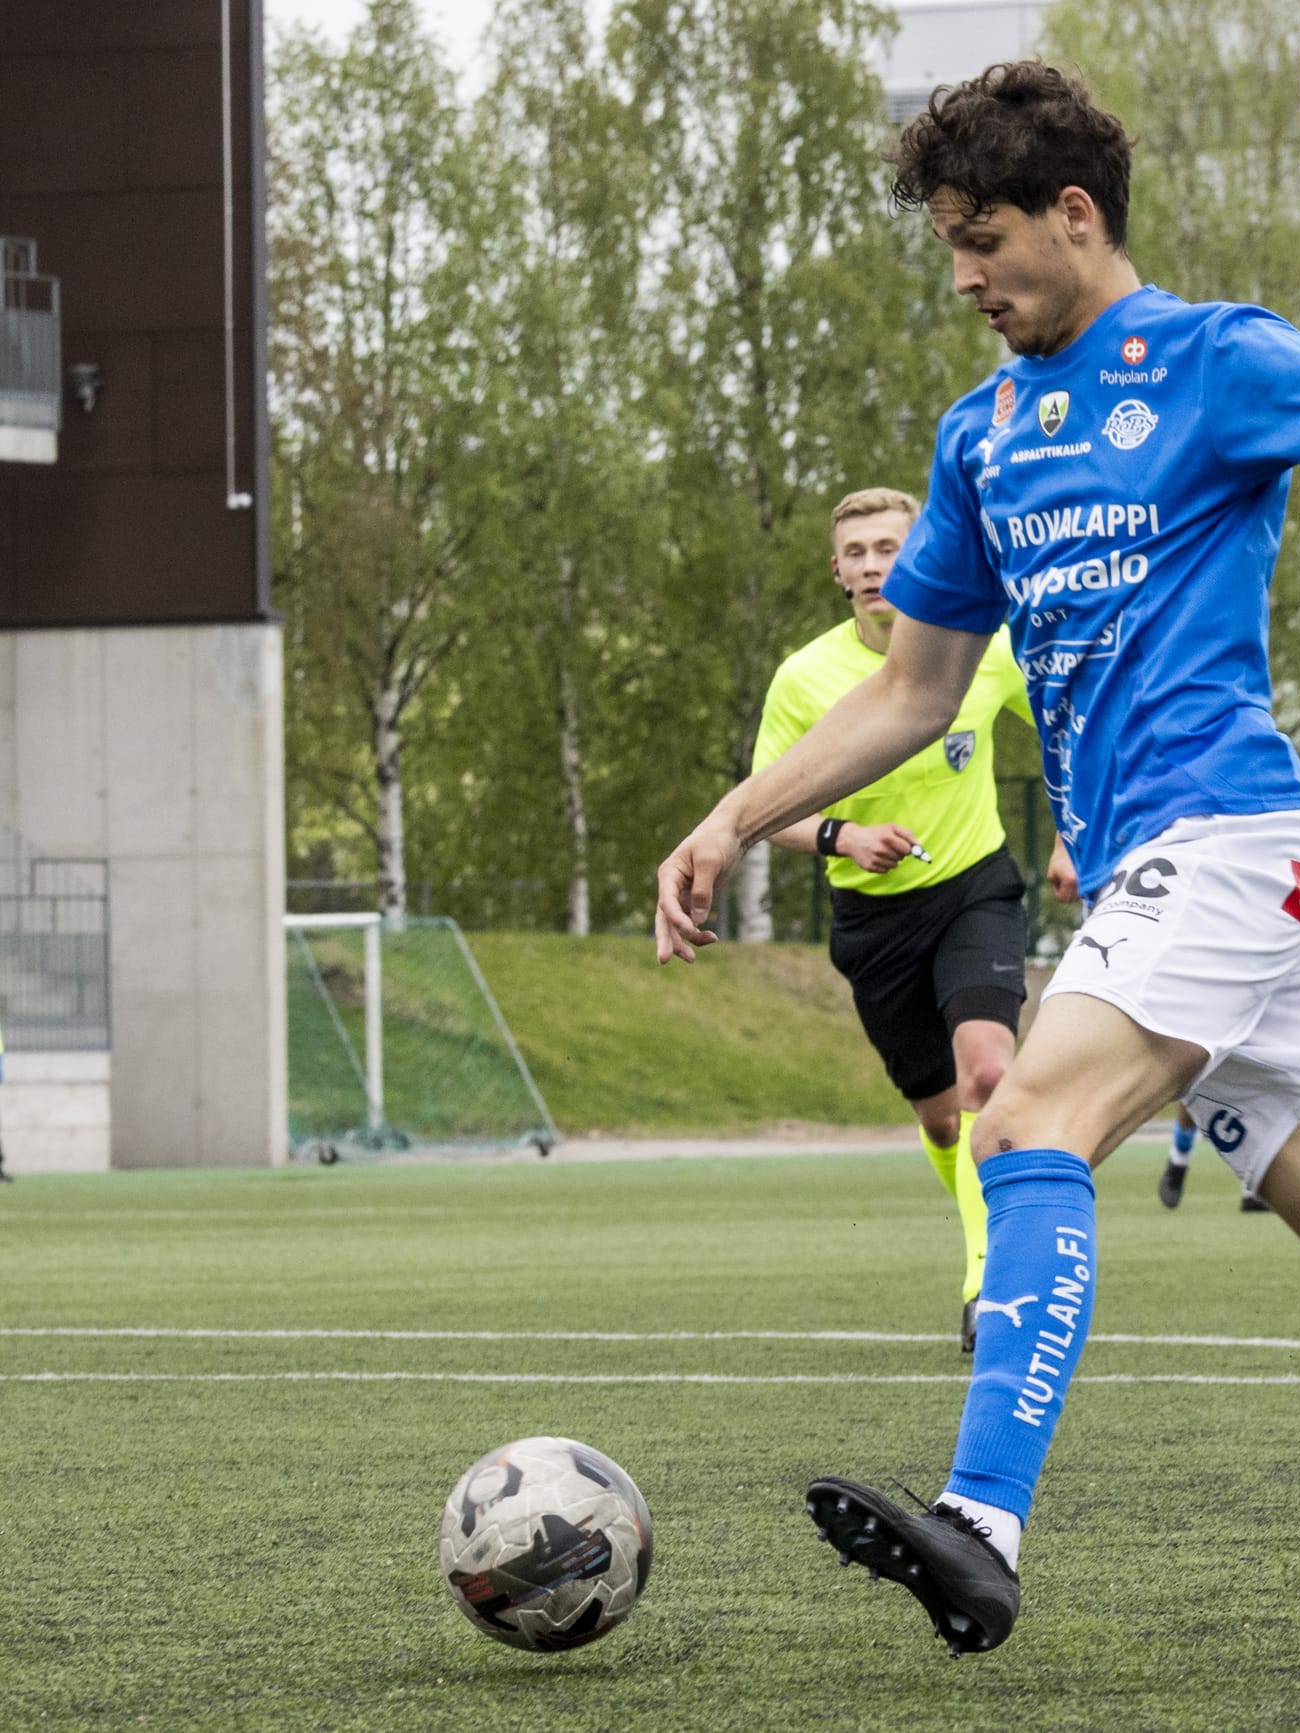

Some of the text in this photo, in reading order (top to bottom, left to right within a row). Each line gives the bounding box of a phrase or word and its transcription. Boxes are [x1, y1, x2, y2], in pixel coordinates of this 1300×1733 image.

[1100, 368, 1168, 387] Pohjolan OP
[1007, 504, 1159, 549] ROVALAPPI
[1030, 607, 1068, 628] ORT
